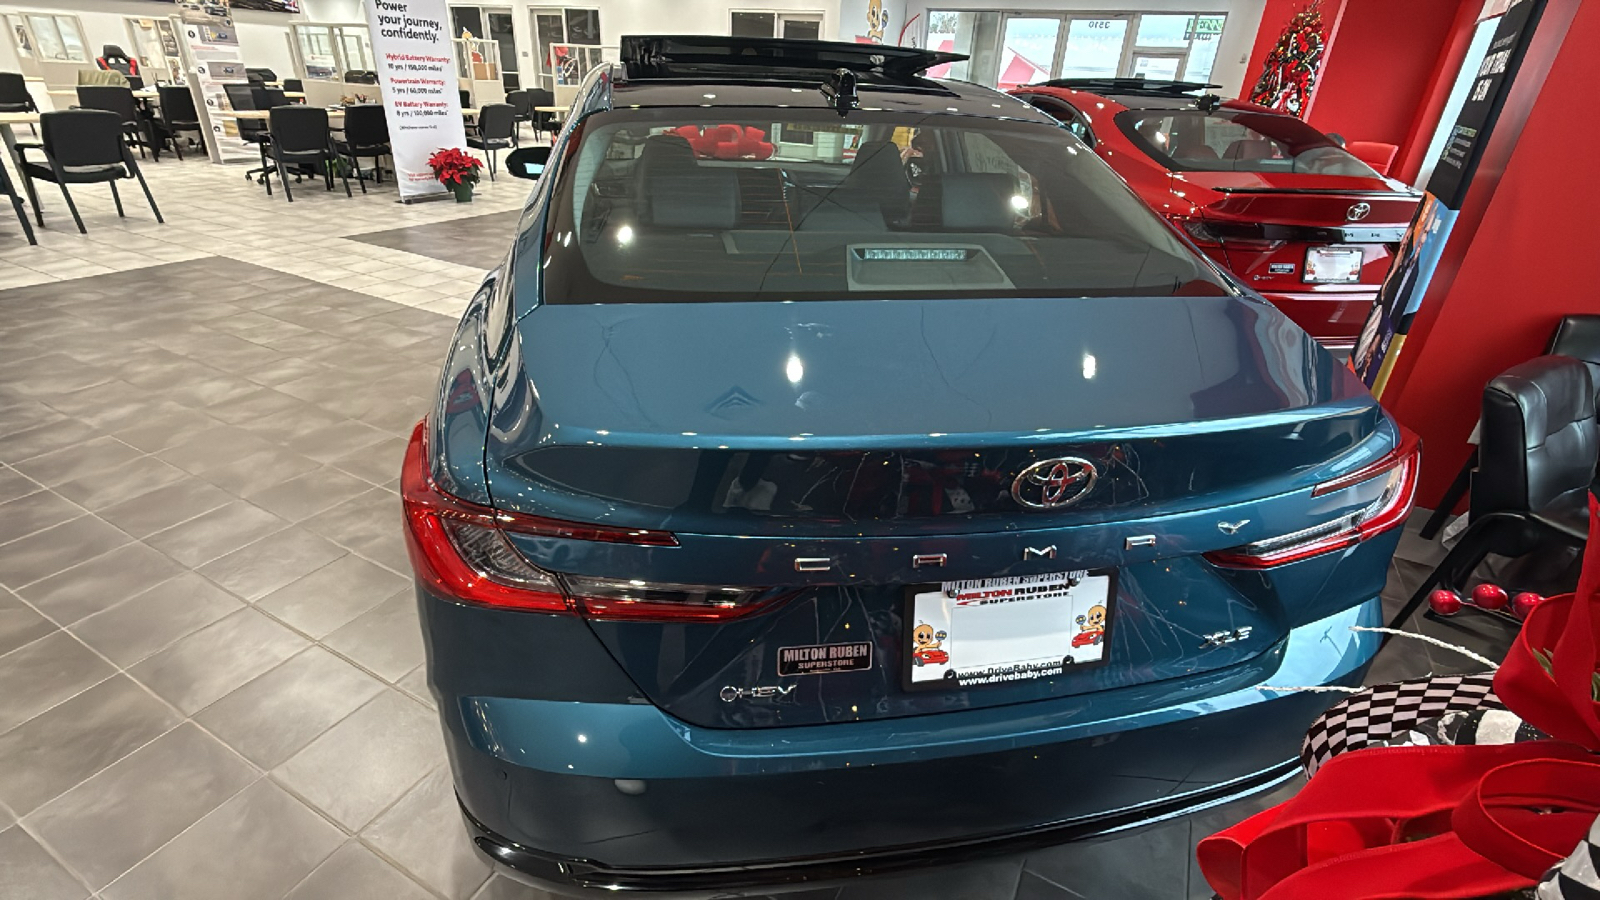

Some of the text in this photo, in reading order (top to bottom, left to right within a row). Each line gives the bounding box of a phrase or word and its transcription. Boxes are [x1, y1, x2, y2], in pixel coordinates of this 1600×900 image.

[374, 0, 408, 12] Power
[377, 14, 442, 31] your journey,
[381, 27, 440, 44] confidently.
[941, 579, 982, 592] MILTON
[984, 576, 1020, 591] RUBEN
[956, 583, 1070, 601] MILTON RUBEN
[979, 591, 1070, 606] SUPERSTORE
[784, 644, 868, 662] MILTON RUBEN
[798, 658, 854, 669] SUPERSTORE
[958, 667, 1062, 686] www.drivebaby.com
